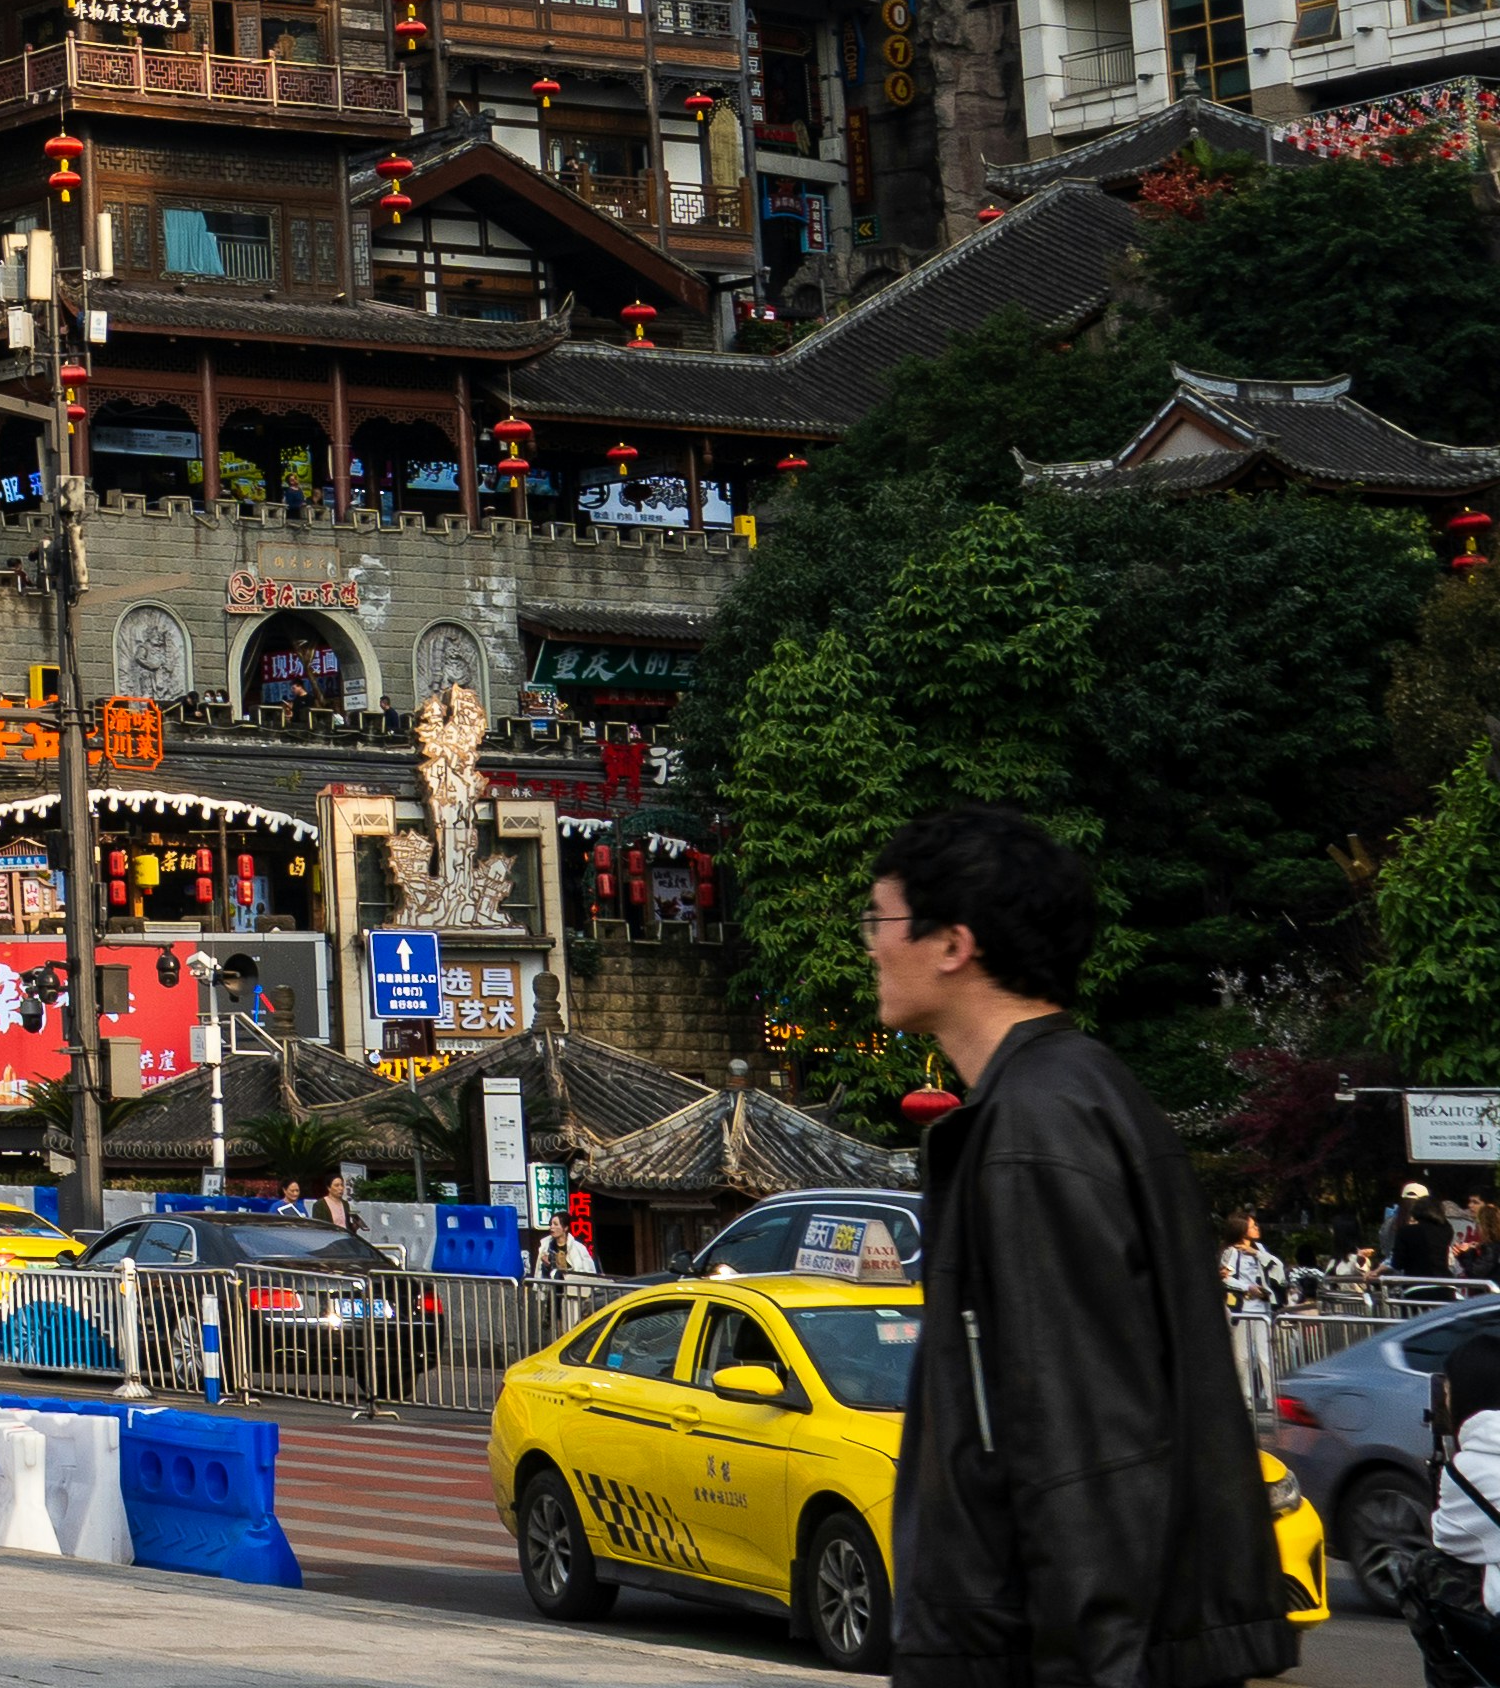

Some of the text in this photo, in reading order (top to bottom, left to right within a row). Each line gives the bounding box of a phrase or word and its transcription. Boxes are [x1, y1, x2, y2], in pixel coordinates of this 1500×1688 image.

[73, 0, 187, 28] 非物质文化遗产
[260, 578, 360, 608] 重庆小天鹅
[537, 1168, 565, 1185] 夜景
[538, 1187, 566, 1206] 游船
[865, 1246, 895, 1255] TAXI
[861, 1259, 900, 1270] 出租汽车
